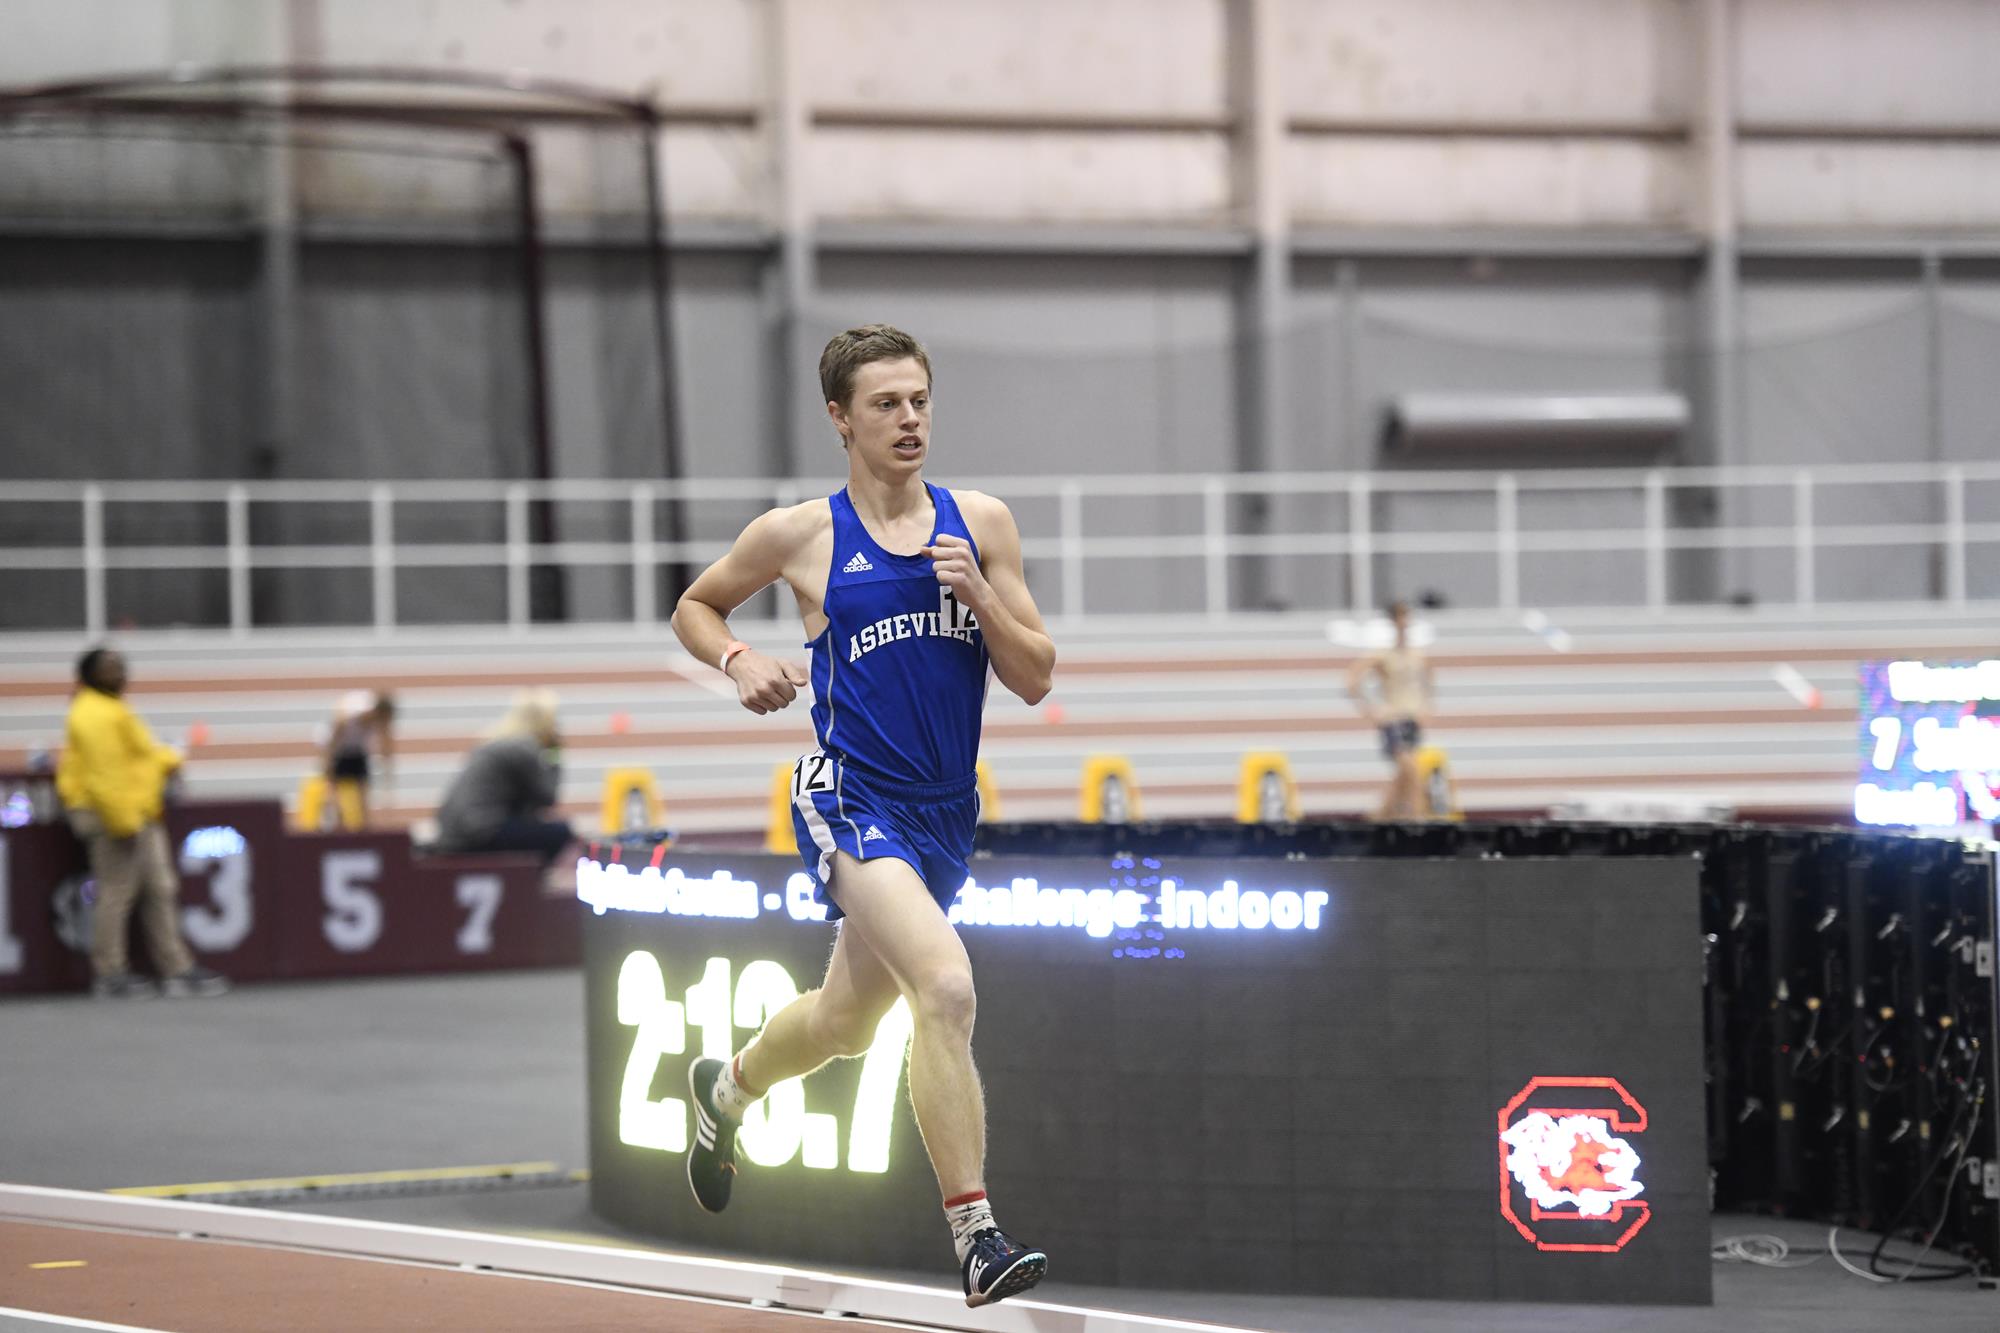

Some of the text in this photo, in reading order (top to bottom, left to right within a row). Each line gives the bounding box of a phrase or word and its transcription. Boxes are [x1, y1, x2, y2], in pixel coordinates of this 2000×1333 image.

[843, 563, 873, 573] adidas
[849, 611, 975, 663] ASHEVI
[794, 756, 826, 797] 12
[180, 825, 254, 952] 3
[321, 850, 382, 953] 5
[455, 874, 502, 953] 7
[948, 877, 1143, 937] hallenge
[1157, 880, 1329, 929] Indoor
